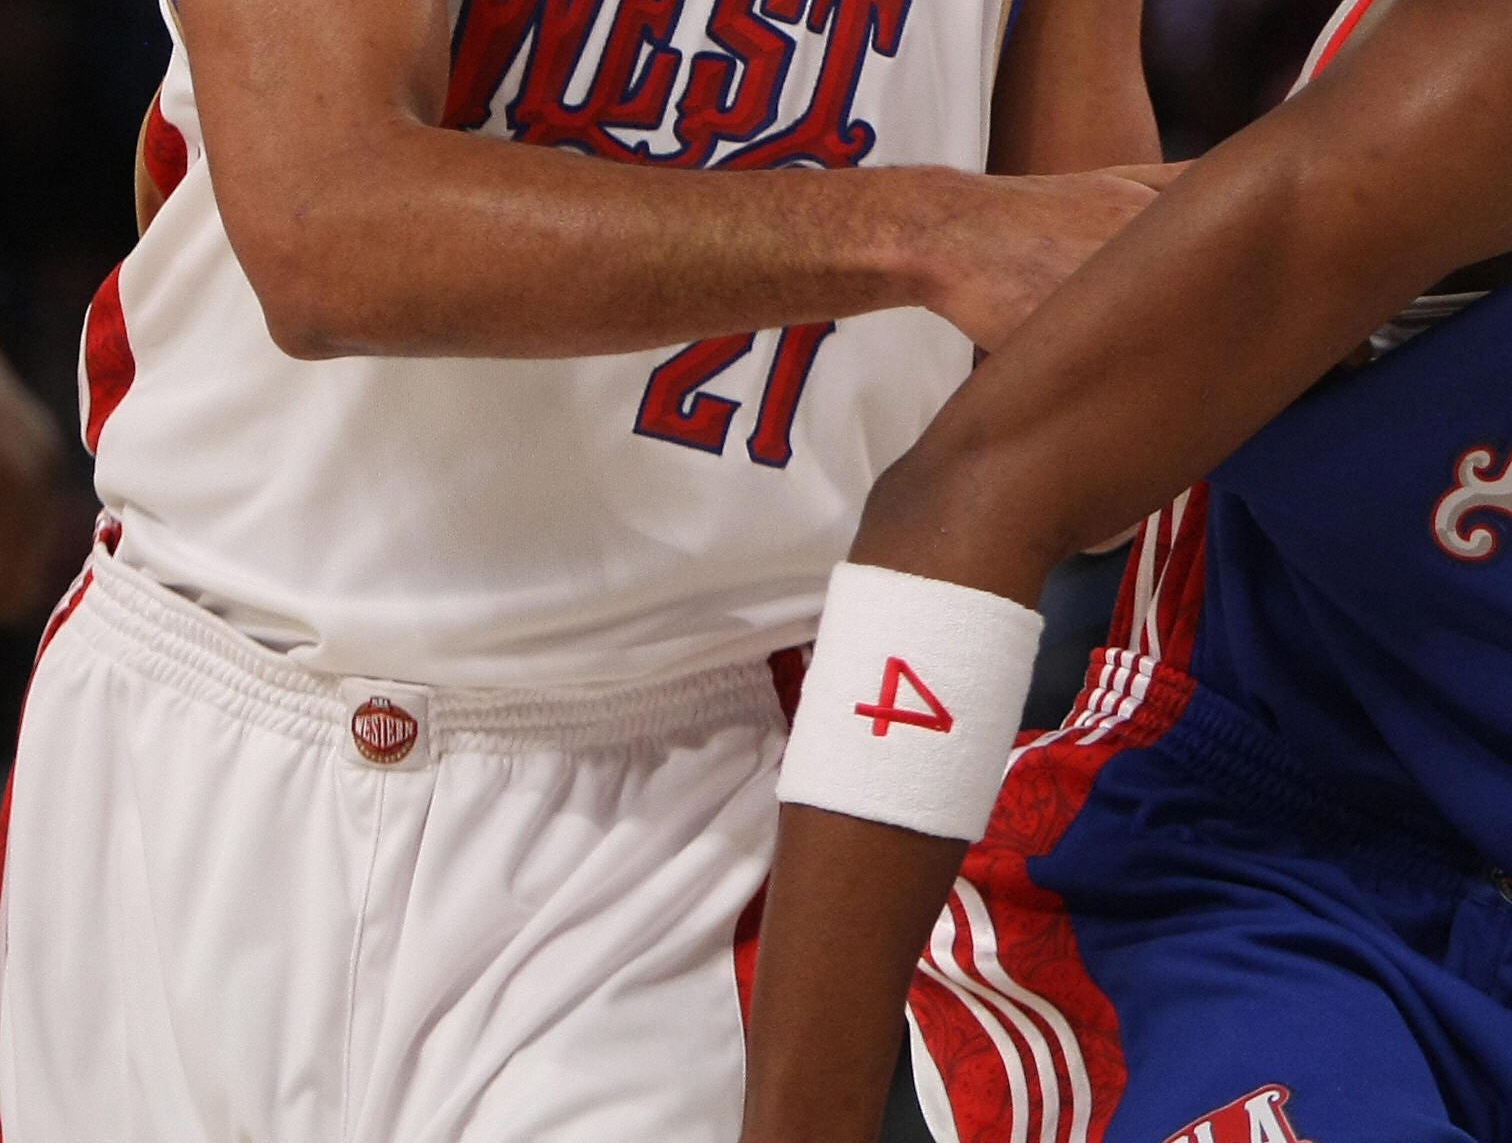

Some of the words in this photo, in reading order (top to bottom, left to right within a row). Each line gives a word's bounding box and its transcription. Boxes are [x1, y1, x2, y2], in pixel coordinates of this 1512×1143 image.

[633, 320, 837, 469] 21
[355, 714, 414, 749] WESTERN
[854, 656, 954, 737] 4
